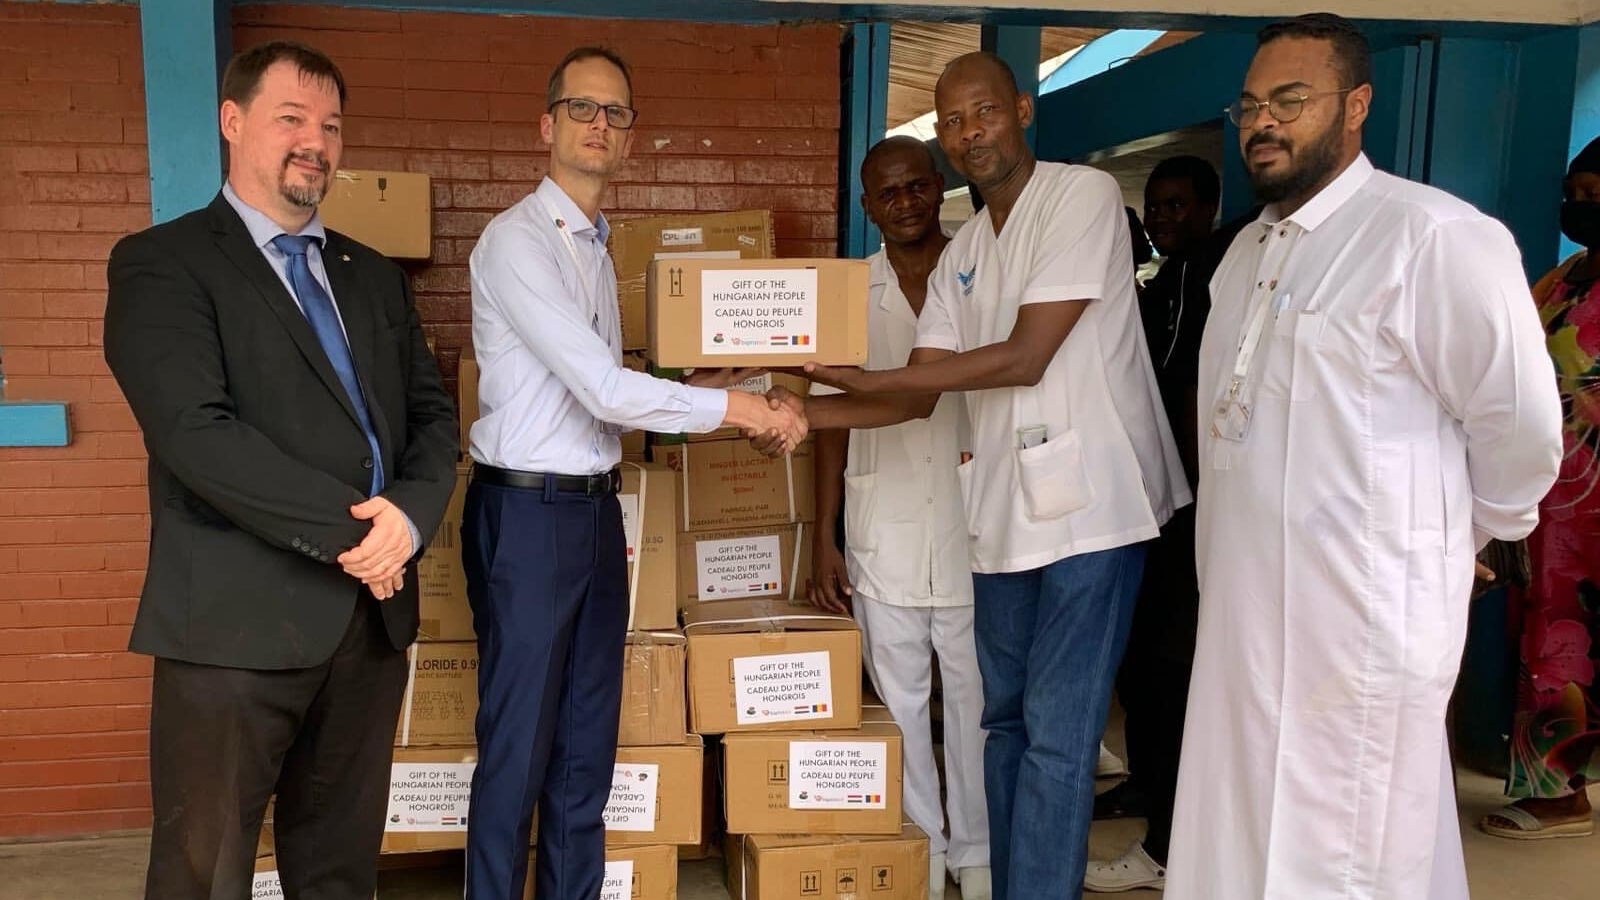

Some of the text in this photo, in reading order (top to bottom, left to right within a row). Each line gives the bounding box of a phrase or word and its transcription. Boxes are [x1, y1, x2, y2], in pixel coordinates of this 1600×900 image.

[732, 280, 786, 289] GIFT OF THE
[713, 291, 805, 301] HUNGARIAN PEOPLE
[715, 308, 803, 317] CADEAU DU PEUPLE
[733, 320, 785, 328] HONGROIS
[719, 546, 733, 554] GIFT
[705, 554, 747, 562] HUNGARIAN
[707, 566, 736, 574] CADEAU
[749, 563, 771, 571] PEUPLE
[721, 573, 759, 581] HONGROIS
[416, 659, 458, 670] LORIDE
[760, 663, 776, 671] GIFT
[777, 662, 788, 670] OF
[744, 670, 821, 682] HUNGARIAN PEOPLE
[747, 686, 779, 694] CADEAU
[794, 682, 820, 691] PEUPLE
[762, 693, 806, 703] HONGROIS
[392, 781, 443, 789] HUNGARIAN
[816, 781, 860, 789] HONGROIS
[393, 794, 427, 802] CADEAU
[612, 793, 645, 801] CADEAU
[255, 880, 272, 889] GIFT
[605, 879, 623, 887] OPLE
[600, 892, 620, 900] EUPLE
